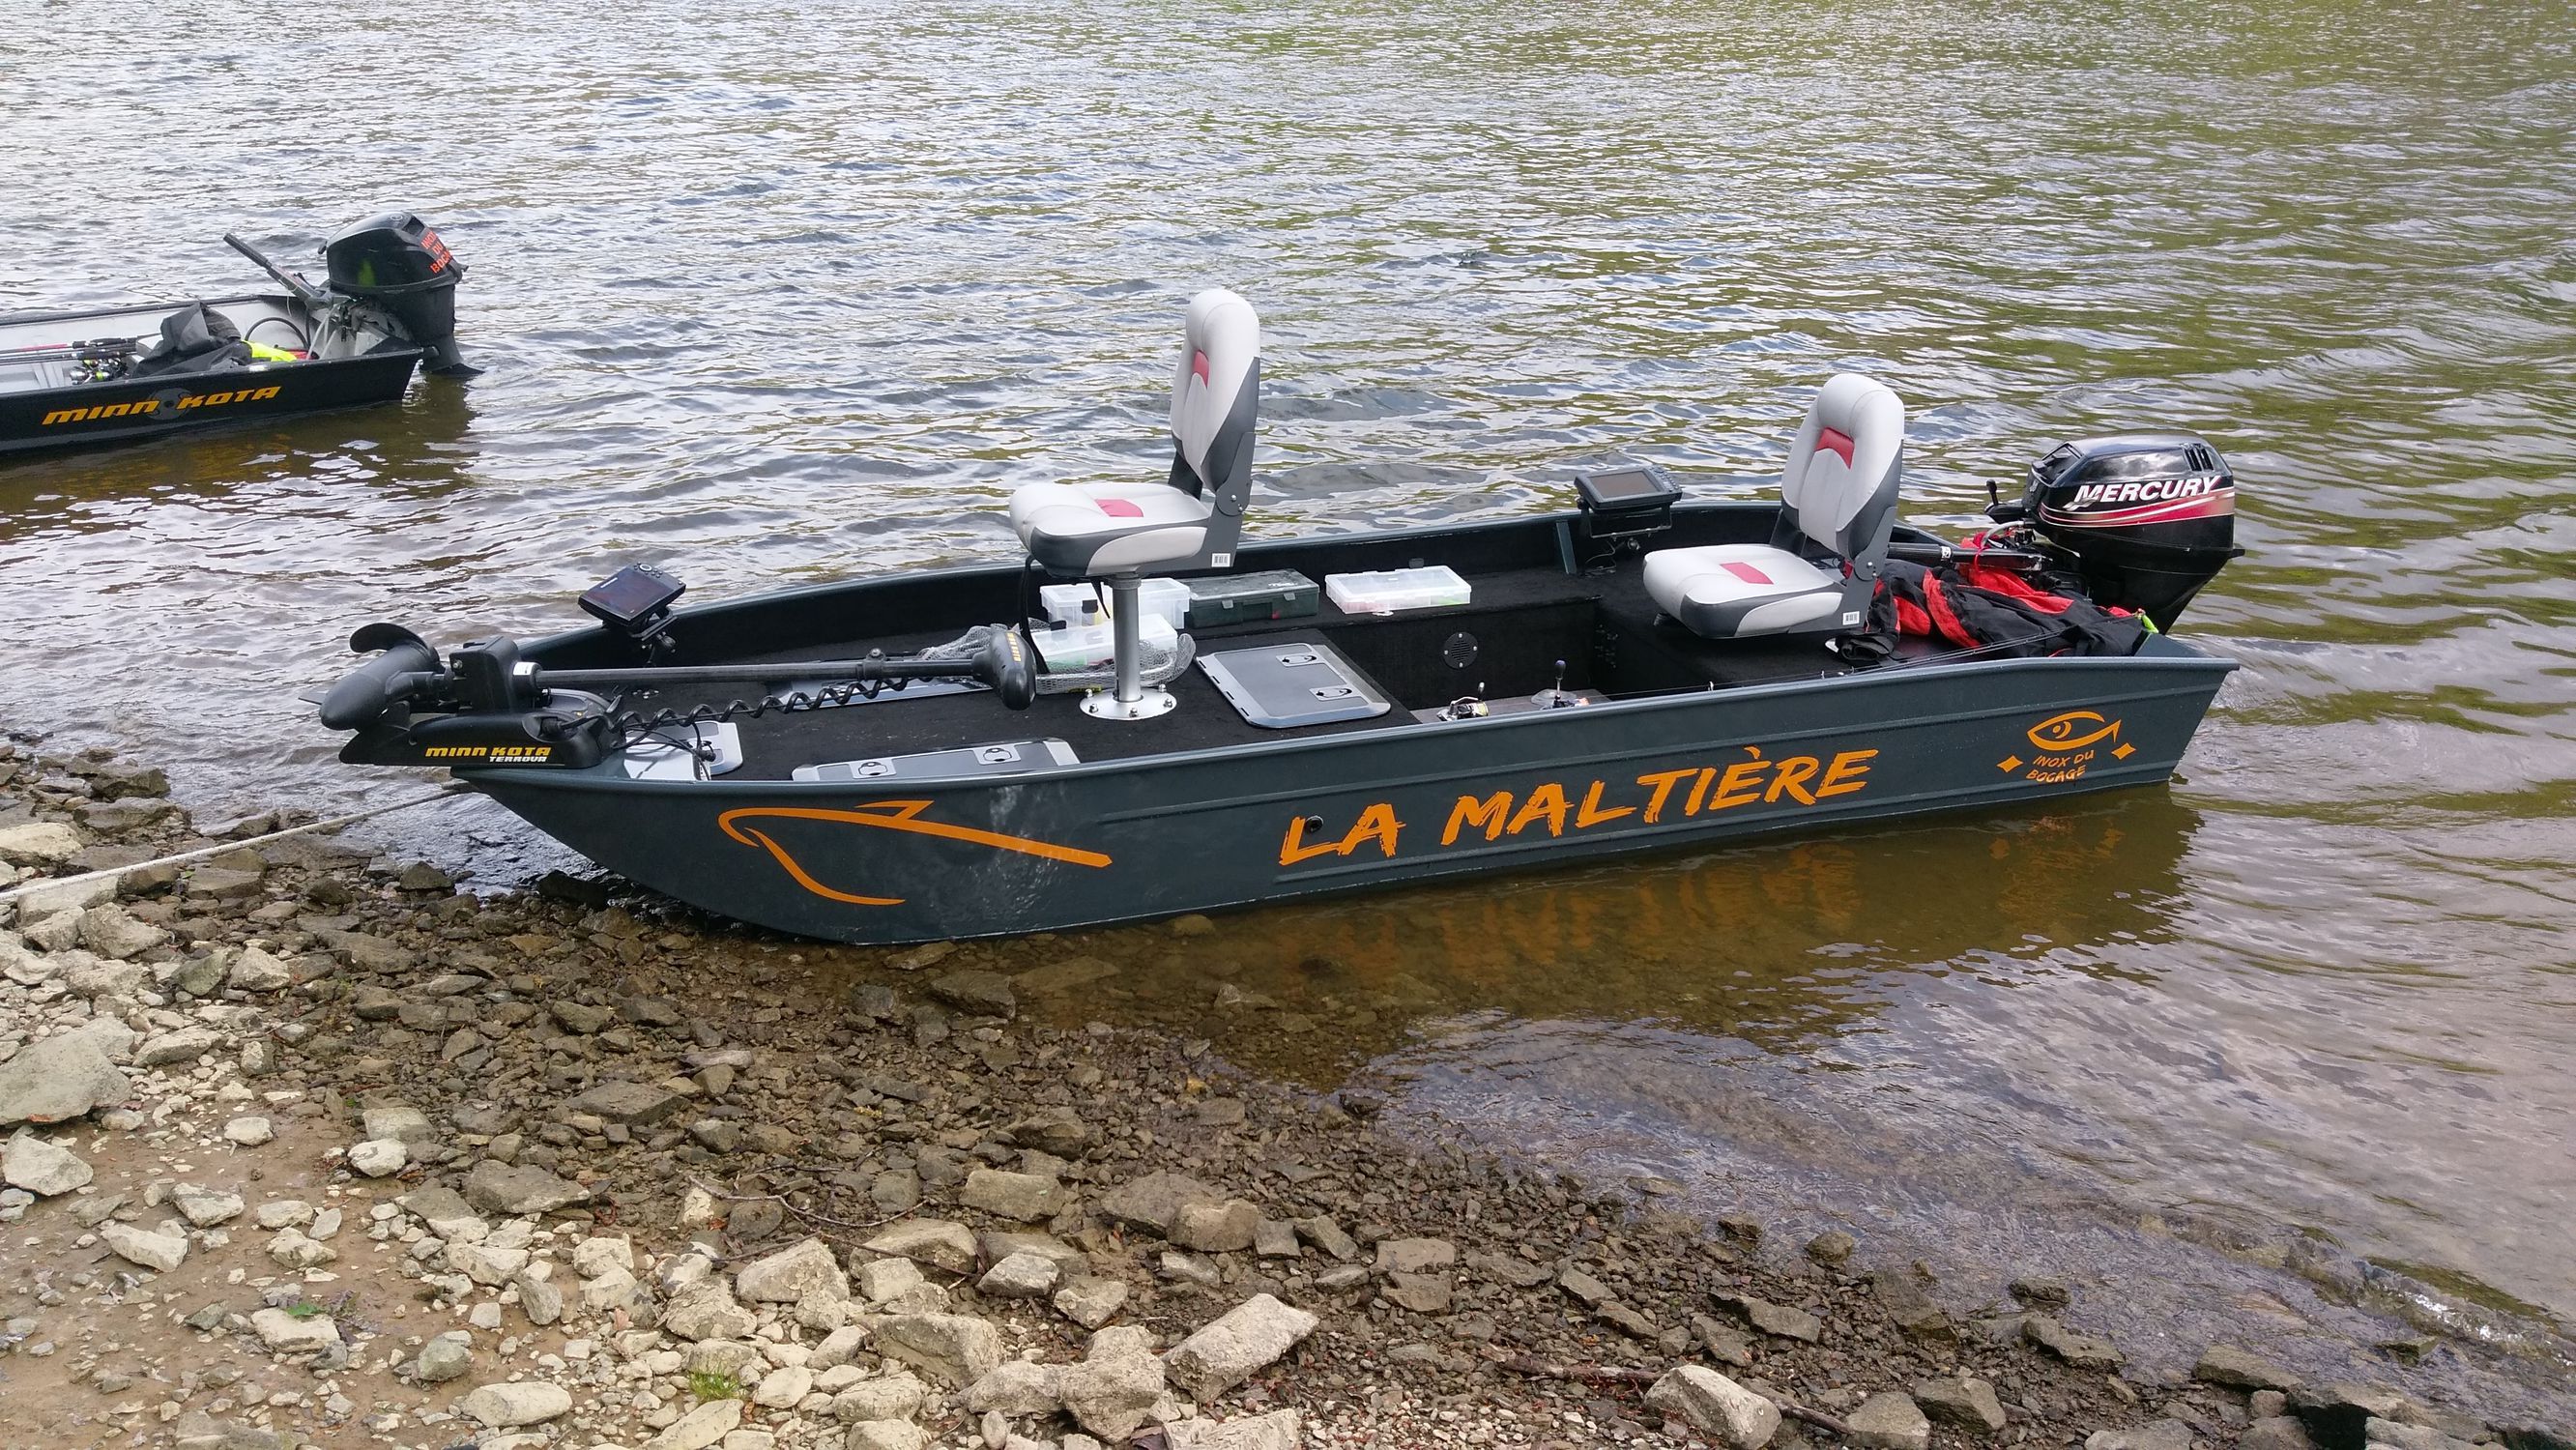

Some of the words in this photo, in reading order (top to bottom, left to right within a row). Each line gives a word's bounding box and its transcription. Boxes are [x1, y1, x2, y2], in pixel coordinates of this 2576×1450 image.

[432, 241, 444, 255] DU
[430, 249, 451, 274] BOCA
[42, 400, 159, 425] MINN
[176, 386, 282, 410] KOTA
[2074, 475, 2221, 504] MERCURY
[425, 747, 487, 757] MINN
[491, 747, 551, 756] KOTA
[2033, 755, 2070, 768] INOX
[2073, 749, 2095, 765] DU
[2026, 764, 2087, 782] BOCAGE
[1278, 803, 1406, 866] LA
[1440, 745, 1879, 846] MALTIÈRE
